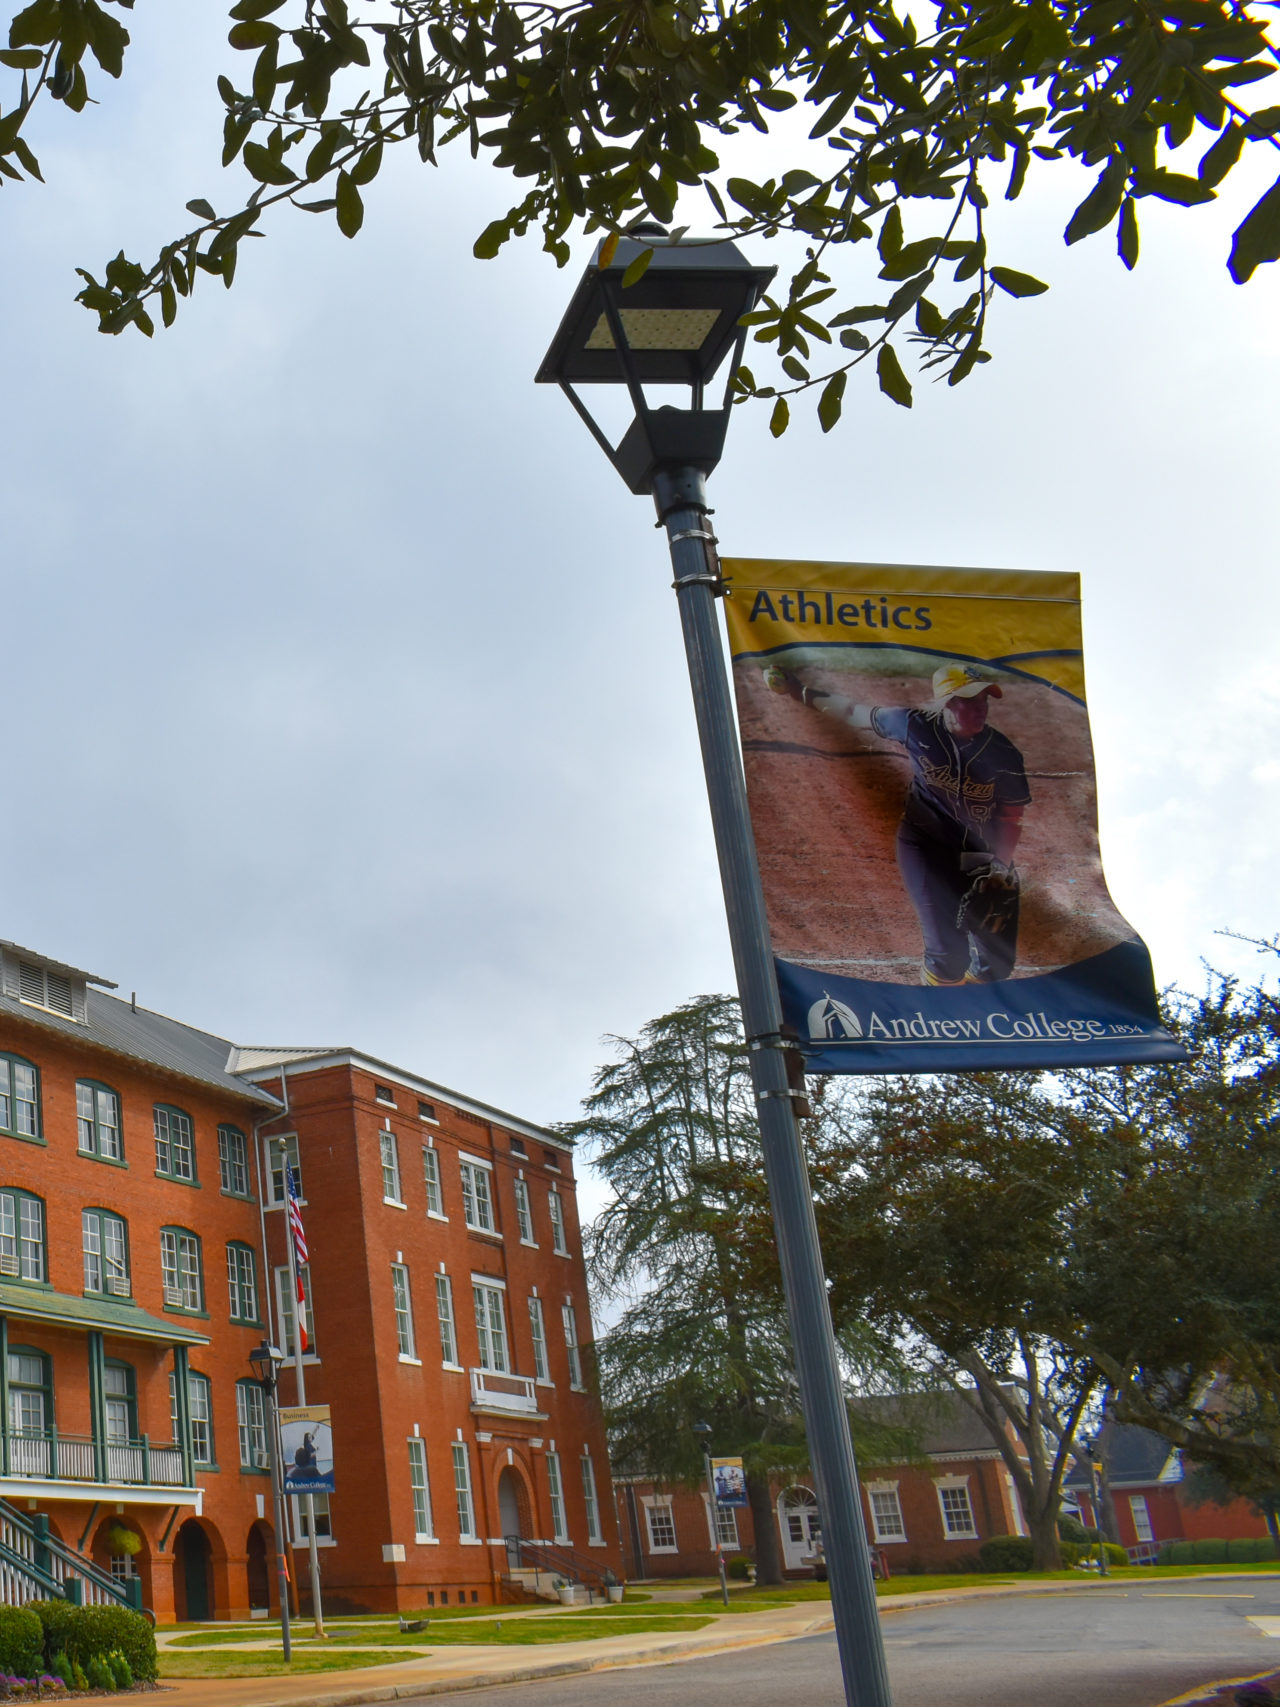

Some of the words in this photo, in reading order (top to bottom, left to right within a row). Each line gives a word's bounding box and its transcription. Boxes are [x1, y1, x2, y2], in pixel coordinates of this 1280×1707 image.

[749, 590, 932, 631] Athletics
[868, 1012, 980, 1039] Andrew
[987, 1012, 1105, 1042] College
[1108, 1024, 1144, 1034] 1854
[282, 1412, 309, 1420] Business
